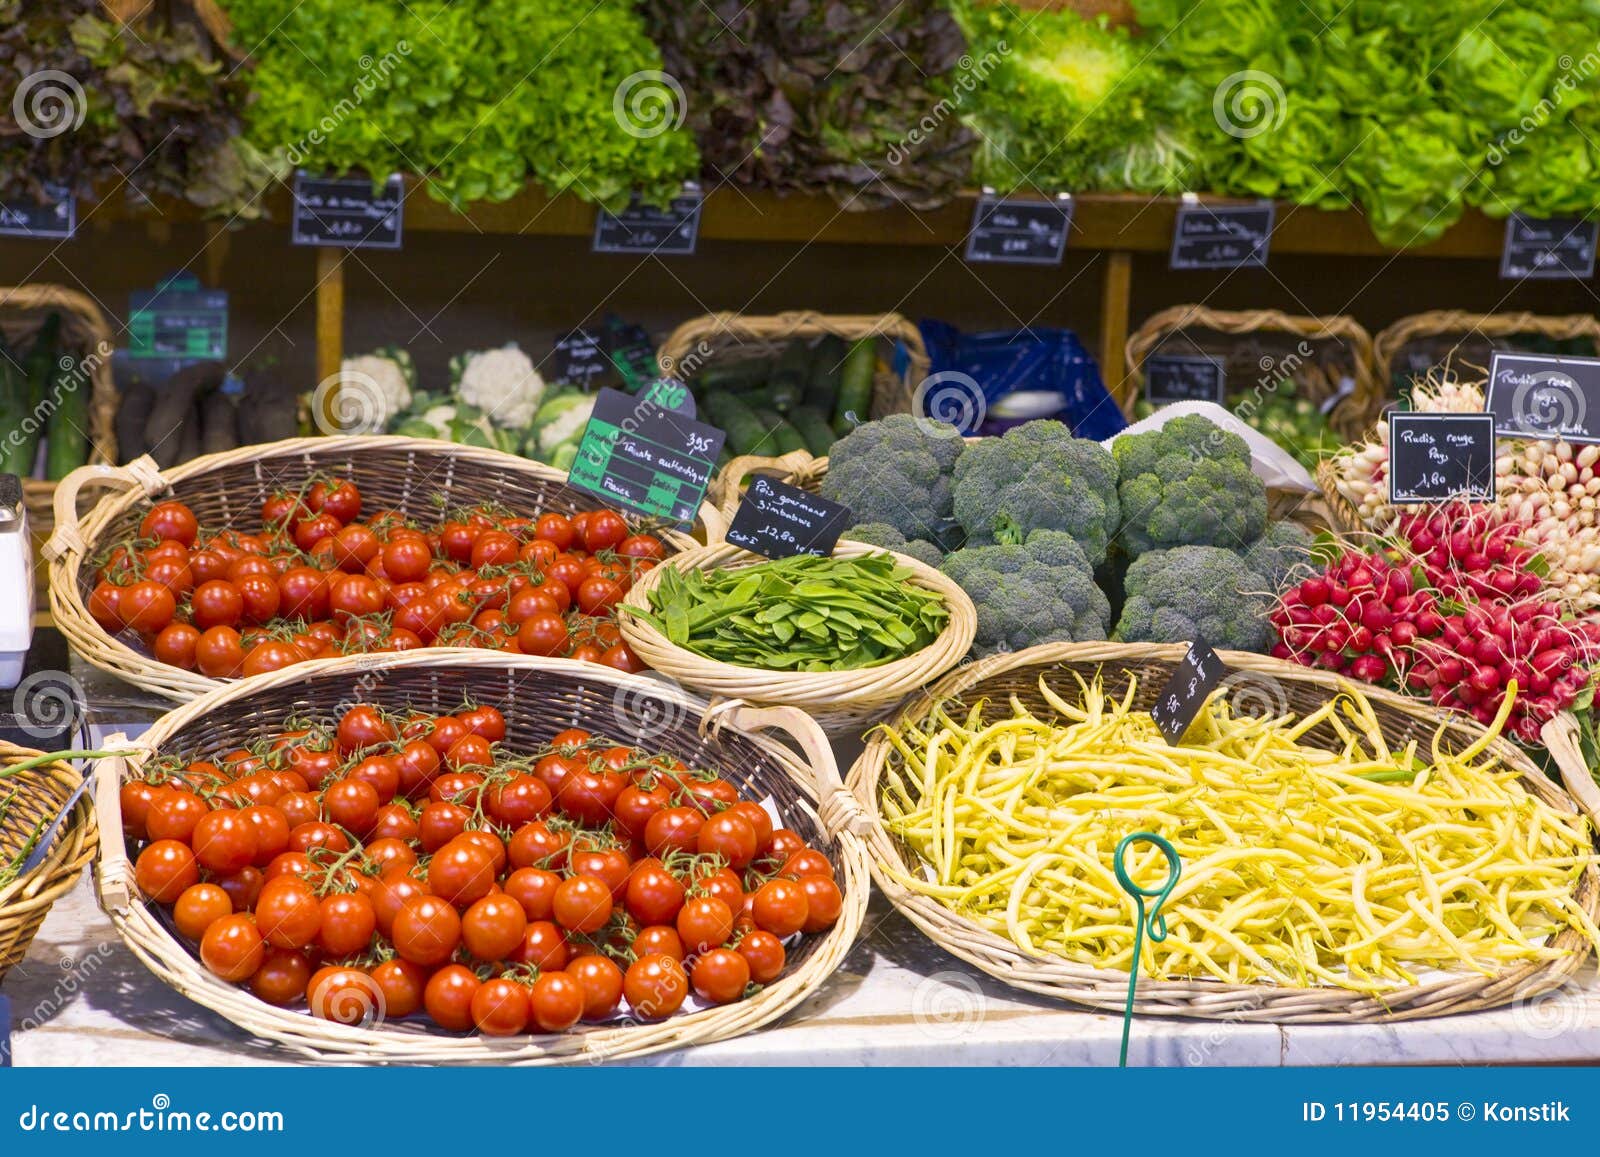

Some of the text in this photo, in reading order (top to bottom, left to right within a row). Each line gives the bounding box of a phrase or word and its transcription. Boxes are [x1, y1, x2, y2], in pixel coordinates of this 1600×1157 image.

[1401, 430, 1475, 447] Radis rouge
[755, 480, 827, 517] Pois gourmand
[757, 525, 795, 543] 12,80
